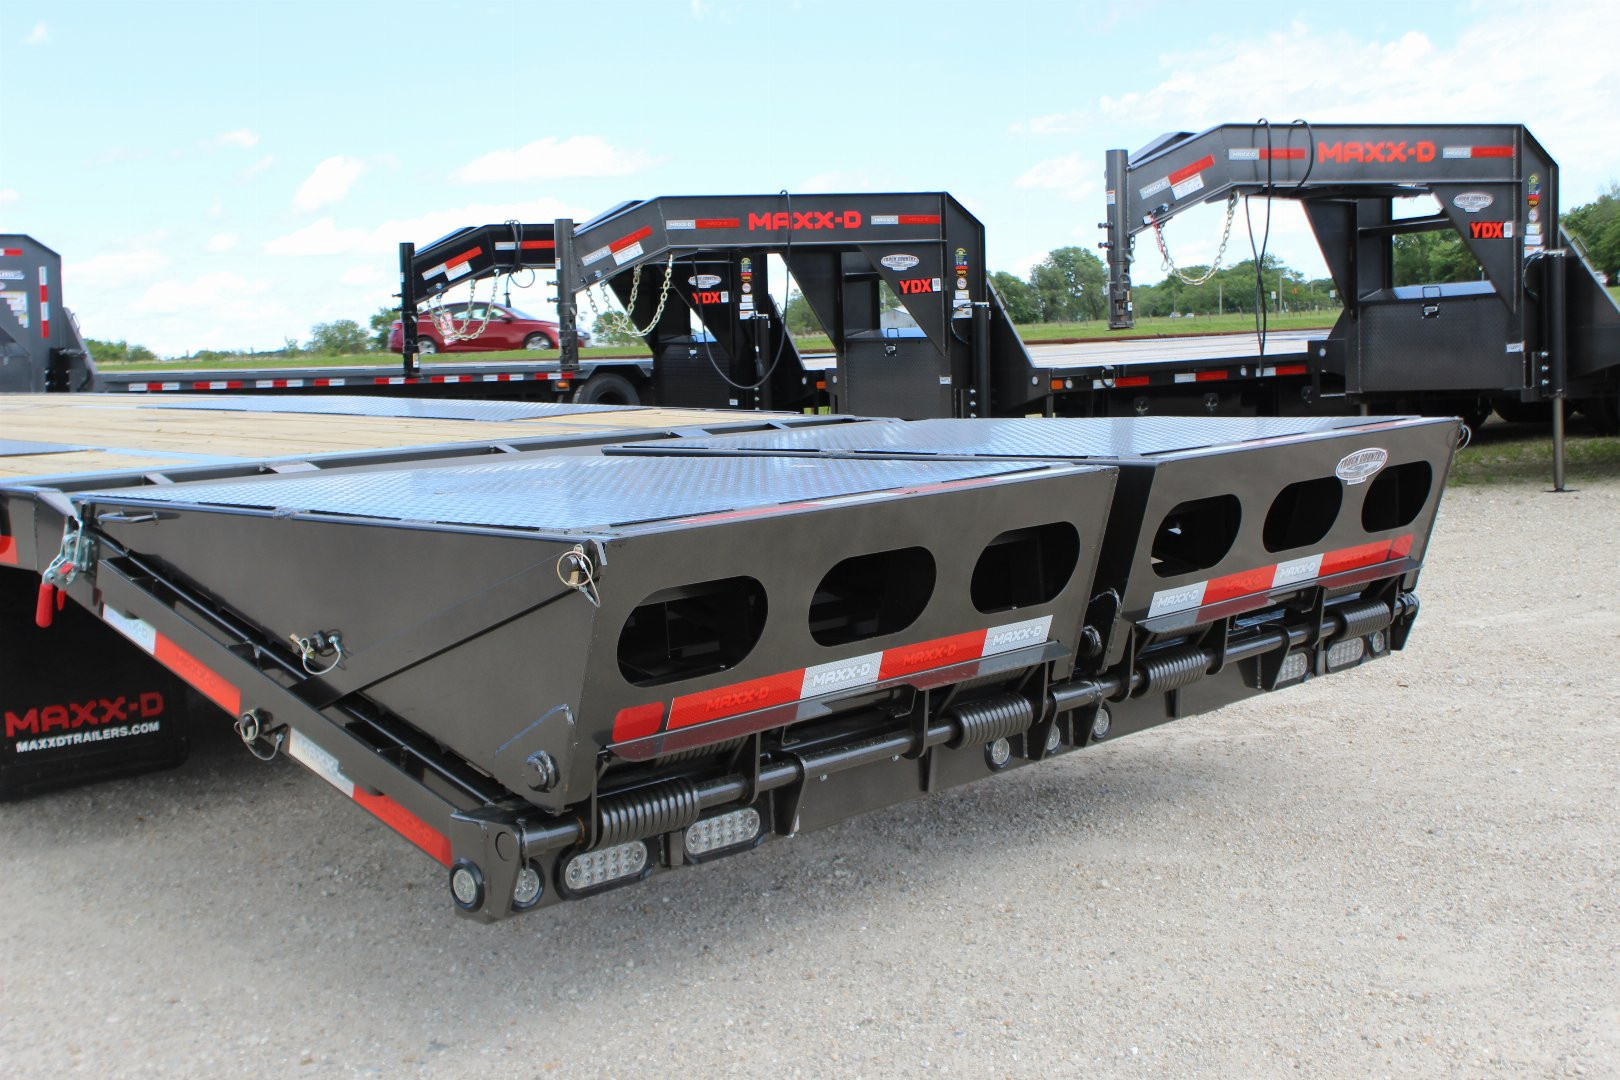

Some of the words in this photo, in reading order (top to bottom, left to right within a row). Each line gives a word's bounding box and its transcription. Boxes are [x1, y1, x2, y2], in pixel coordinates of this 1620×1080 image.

[1317, 140, 1436, 164] MAXX-D
[748, 210, 862, 231] MAXX-D
[1470, 222, 1504, 239] YDX
[899, 278, 932, 294] YDX
[692, 291, 721, 305] YDX
[1157, 589, 1199, 608] MAXX-D
[993, 625, 1042, 646] MAXX-D
[812, 663, 870, 686] MAXX-D
[4, 692, 164, 737] MAXX-D
[16, 721, 160, 753] MAXXDTRAILERS.COM
